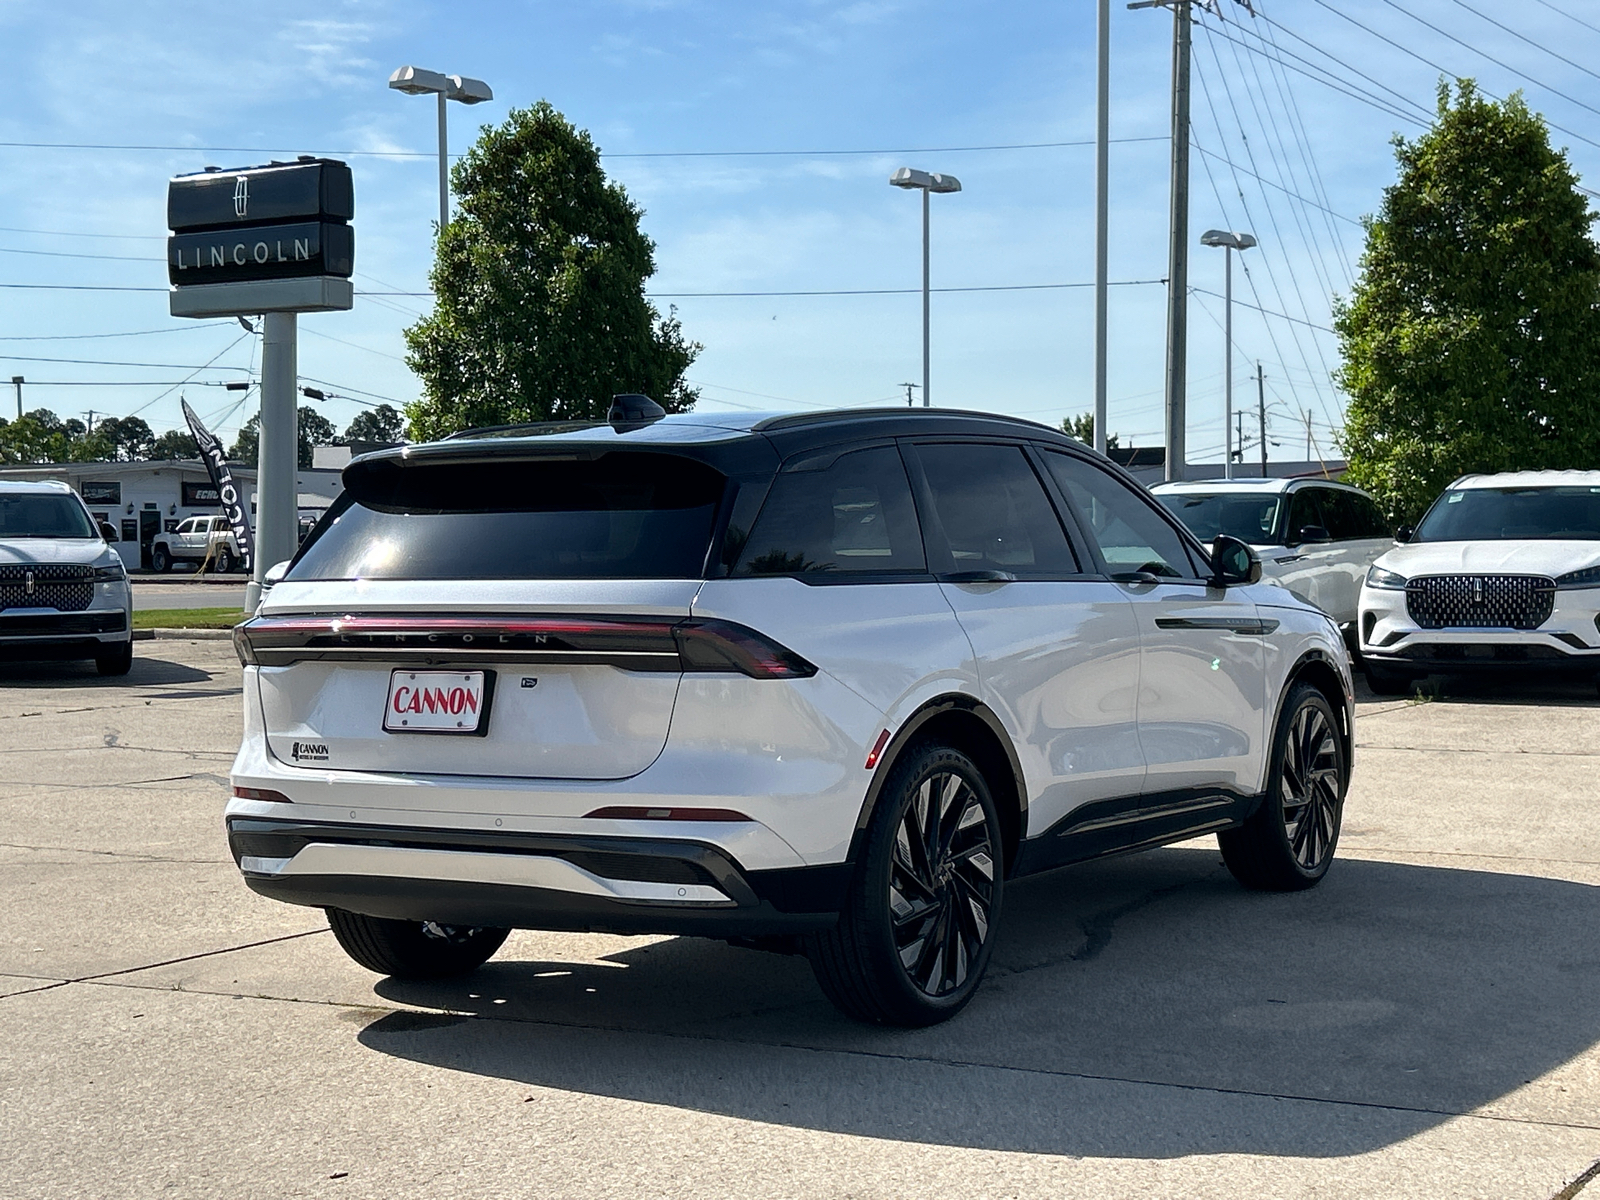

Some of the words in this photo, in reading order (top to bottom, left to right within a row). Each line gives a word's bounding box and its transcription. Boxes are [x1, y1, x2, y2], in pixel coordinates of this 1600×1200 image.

[178, 238, 309, 270] LINCOLN
[340, 633, 548, 644] LINCOLN
[393, 686, 479, 715] CANNON
[299, 743, 329, 755] CANNON
